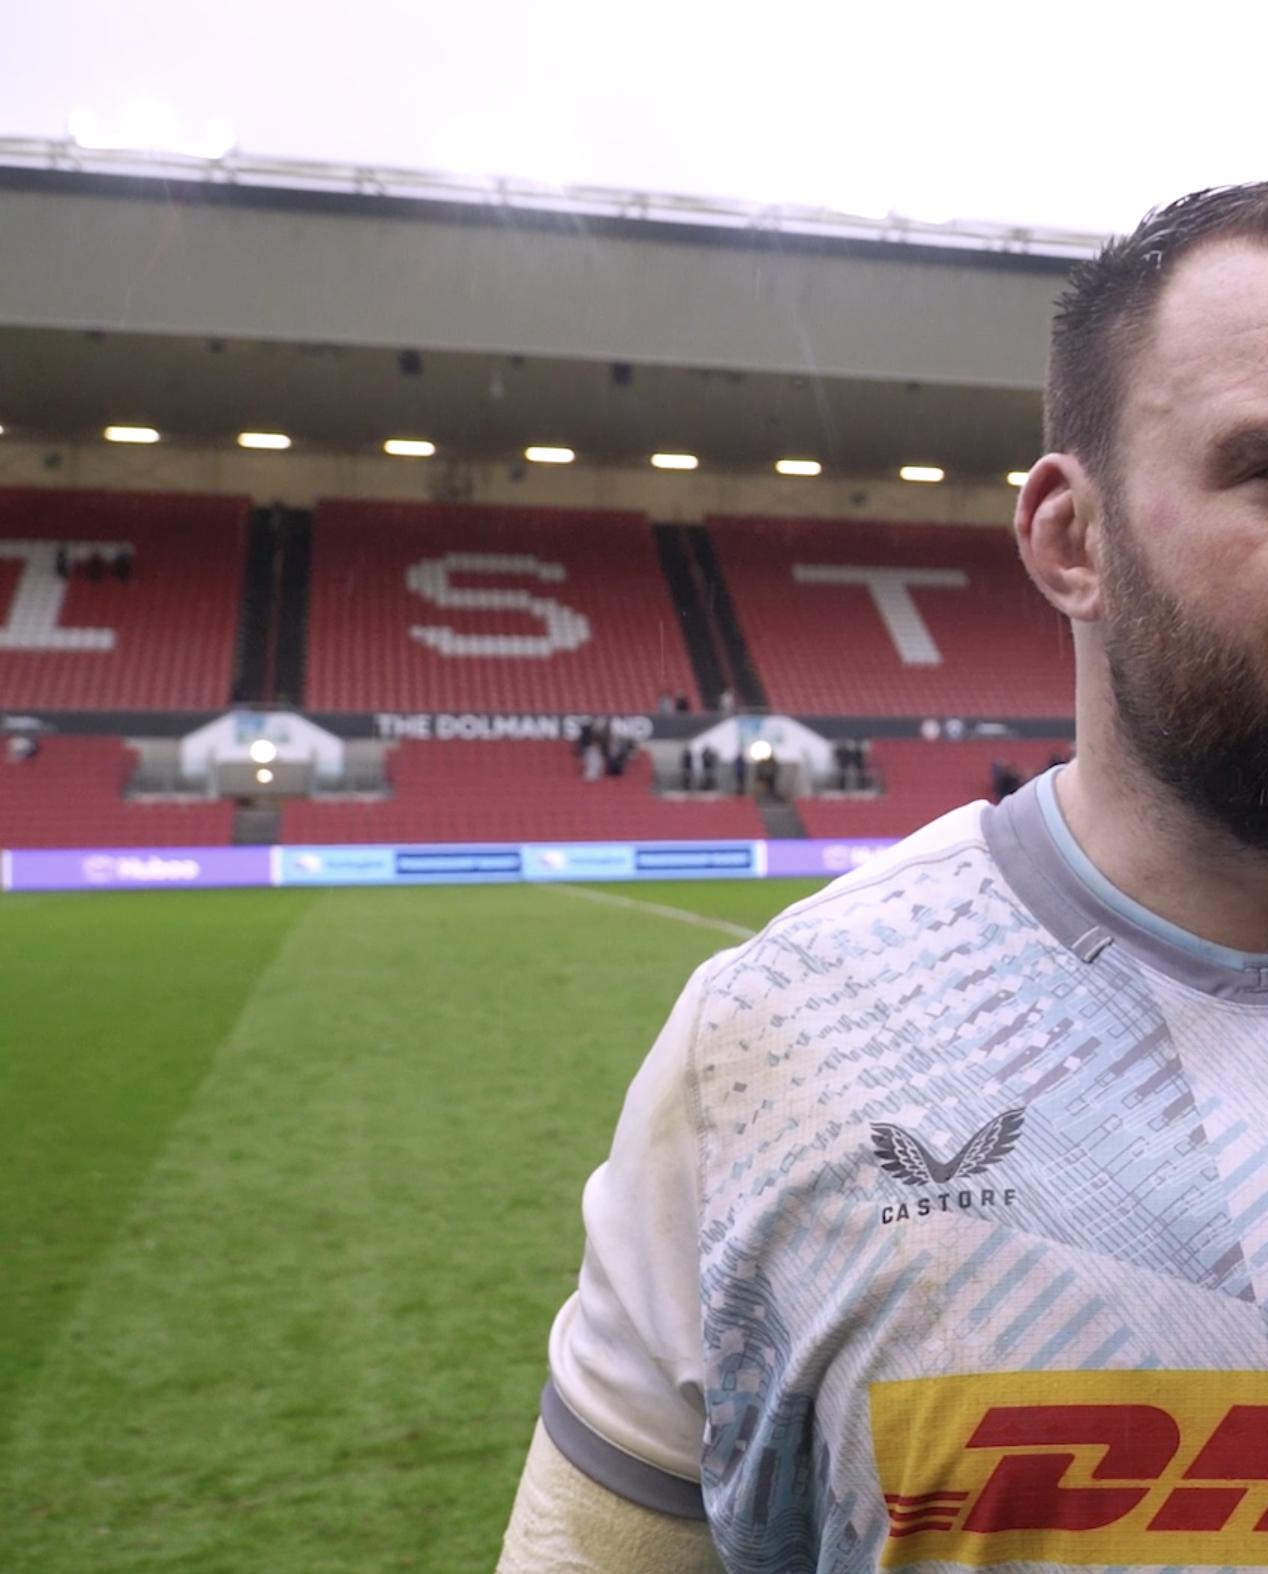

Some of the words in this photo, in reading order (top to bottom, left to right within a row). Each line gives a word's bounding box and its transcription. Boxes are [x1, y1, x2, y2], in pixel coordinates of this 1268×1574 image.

[377, 713, 431, 740] THE
[436, 713, 558, 741] DOLMAN
[881, 1189, 1016, 1225] CASTORE
